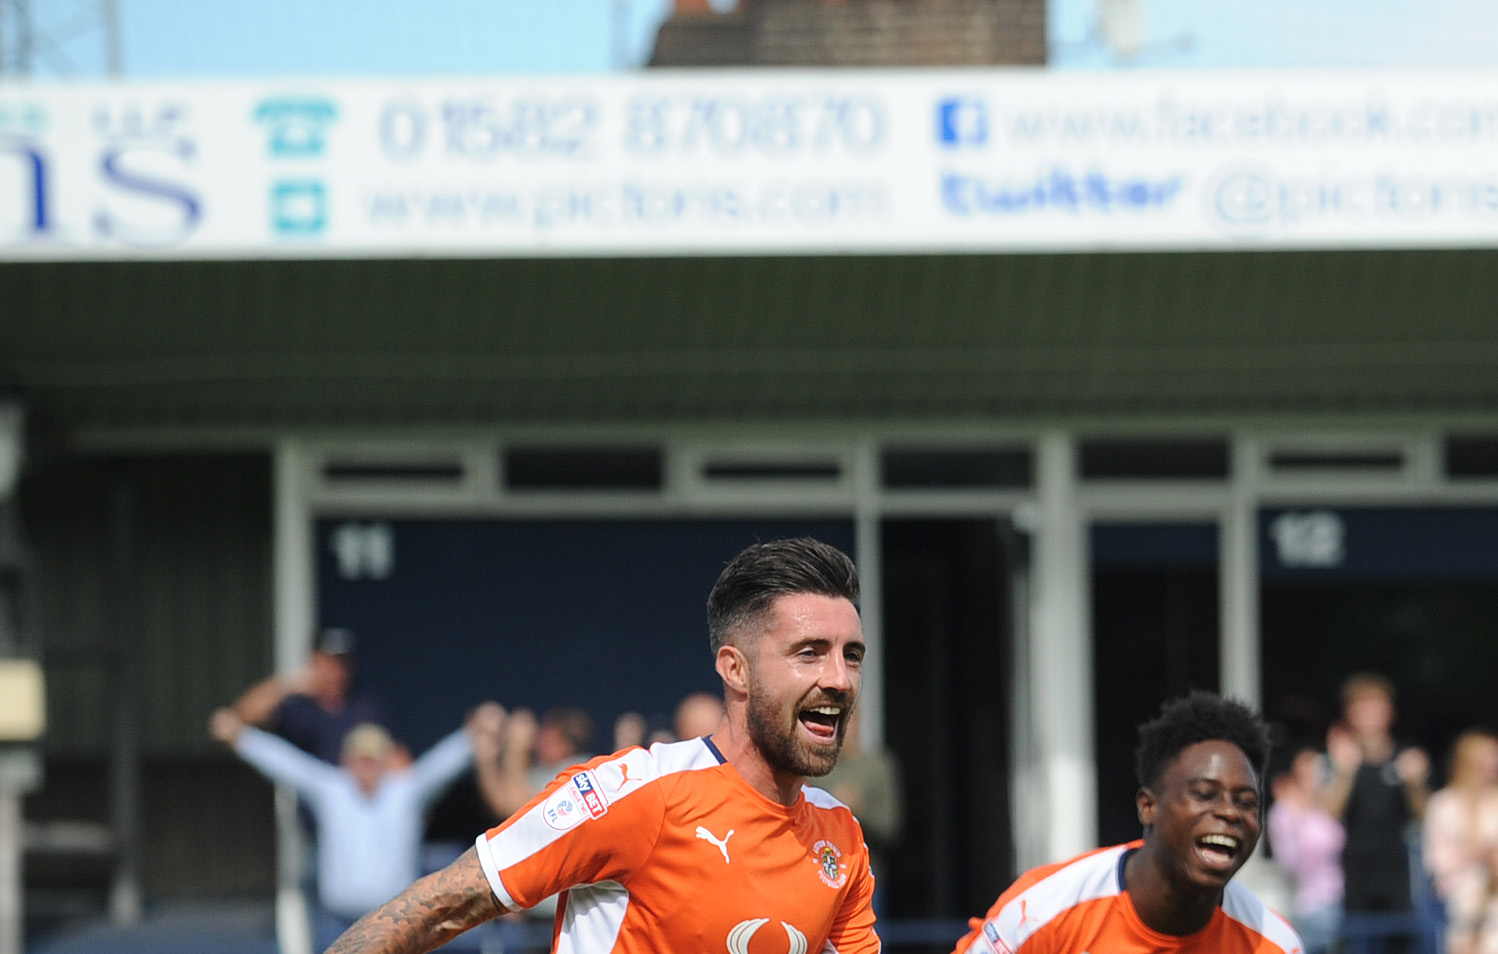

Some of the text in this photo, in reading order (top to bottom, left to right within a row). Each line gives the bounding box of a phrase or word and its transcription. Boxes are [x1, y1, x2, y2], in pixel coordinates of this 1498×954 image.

[620, 87, 893, 162] 870870
[939, 163, 1185, 216] twitter
[547, 809, 558, 823] EFL
[585, 794, 602, 814] BET
